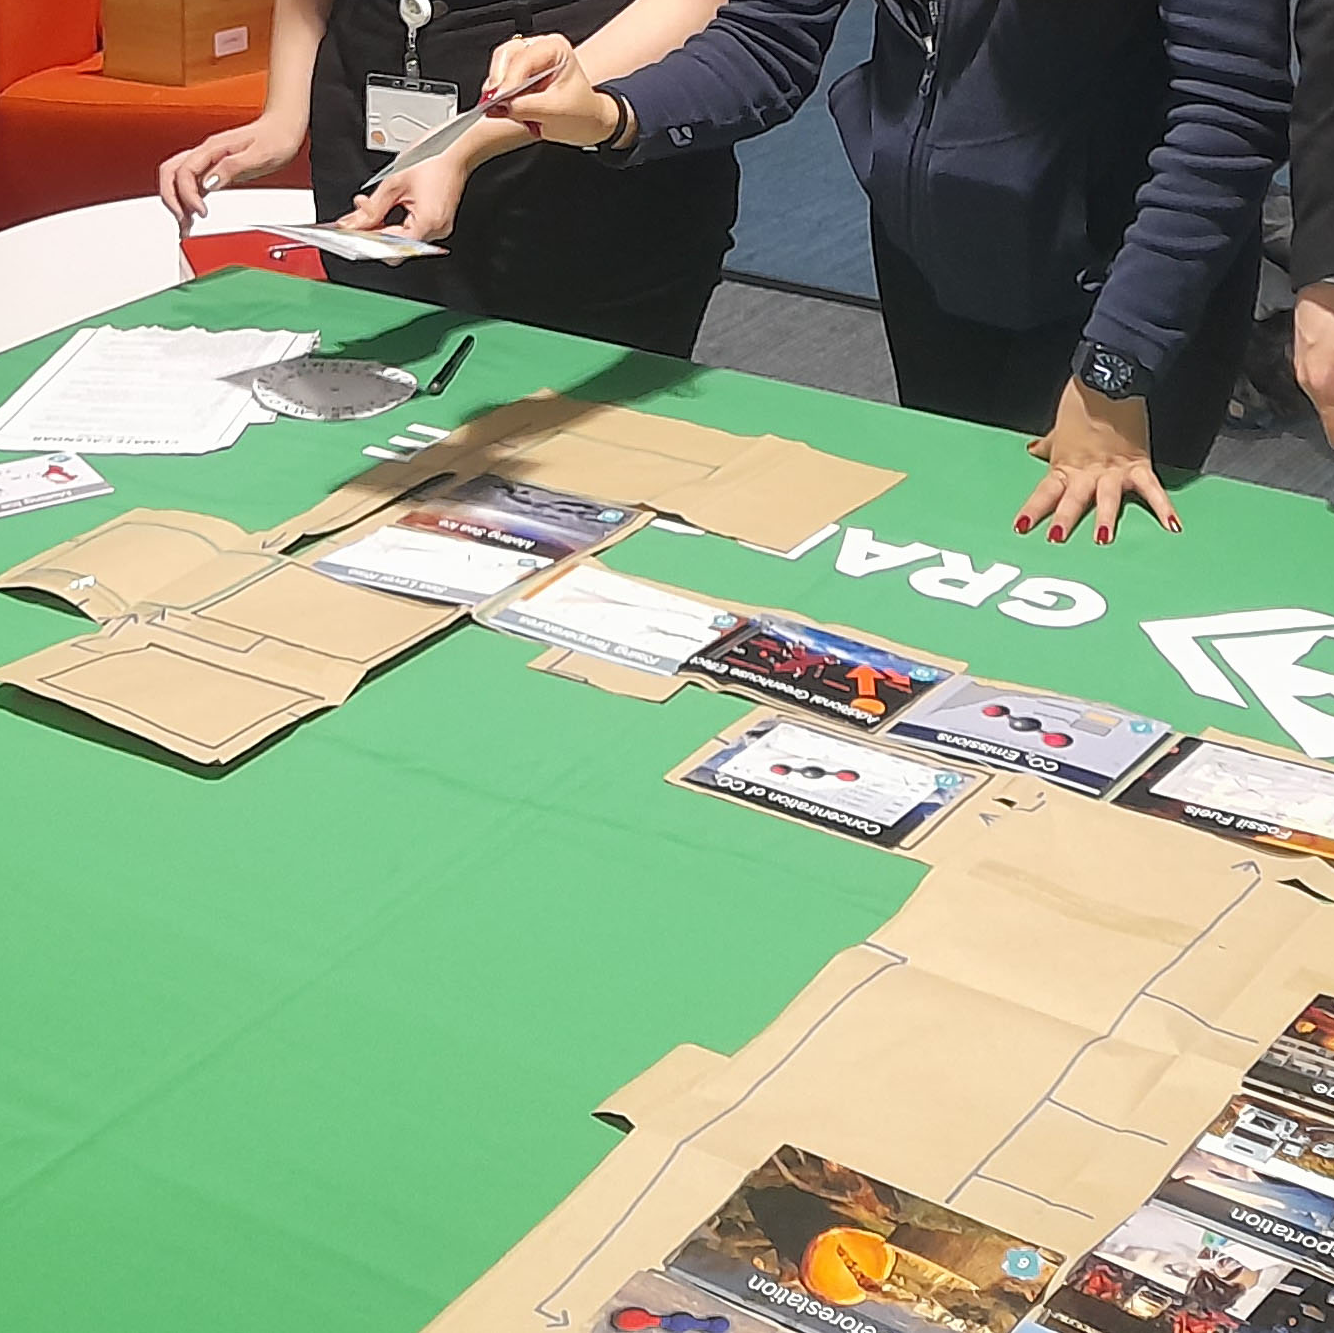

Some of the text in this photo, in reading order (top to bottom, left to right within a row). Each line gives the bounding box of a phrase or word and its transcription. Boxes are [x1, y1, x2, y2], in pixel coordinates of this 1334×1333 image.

[689, 655, 881, 726] Additional Greenhouse Effect
[936, 731, 1021, 763] Emissions
[744, 785, 767, 800] of
[768, 790, 882, 836] Concentration
[1182, 804, 1293, 841] Fossil Fuels
[747, 1273, 878, 1333] eforestation
